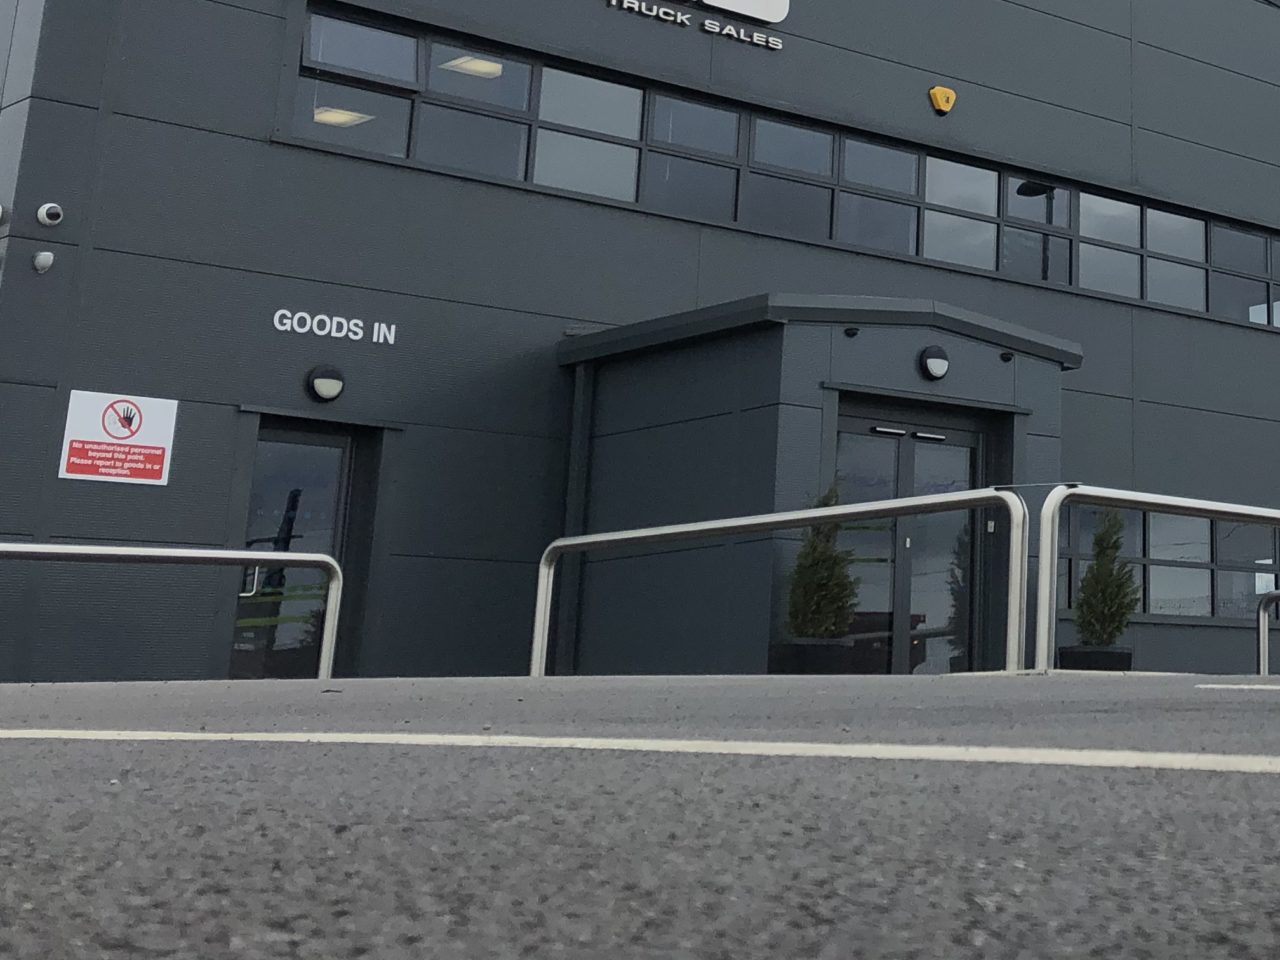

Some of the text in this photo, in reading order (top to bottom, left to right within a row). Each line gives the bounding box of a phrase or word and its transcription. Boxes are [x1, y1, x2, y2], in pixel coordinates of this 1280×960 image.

[703, 19, 783, 50] SALES
[273, 309, 396, 345] GOODS IN
[71, 441, 83, 449] No
[84, 442, 130, 453] unauthorised
[87, 450, 113, 459] beyond
[69, 456, 93, 465] Please
[93, 459, 114, 467] report
[123, 461, 145, 470] goods
